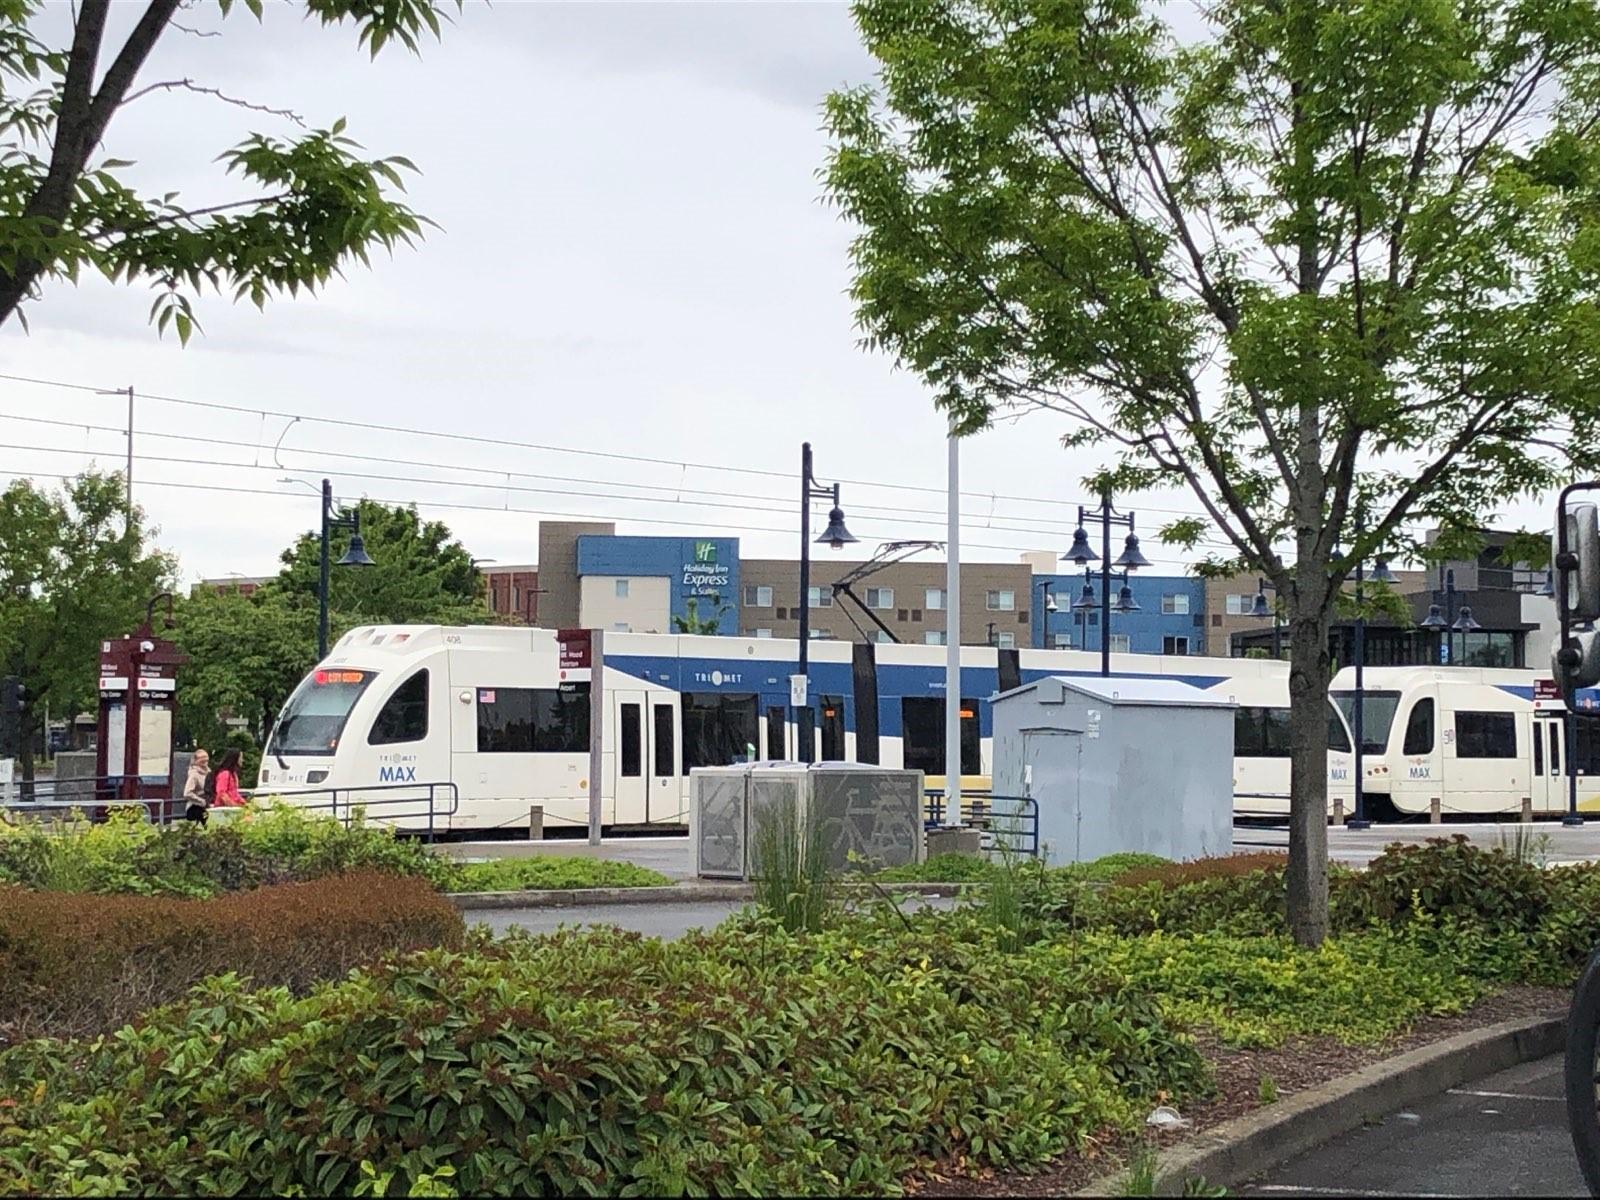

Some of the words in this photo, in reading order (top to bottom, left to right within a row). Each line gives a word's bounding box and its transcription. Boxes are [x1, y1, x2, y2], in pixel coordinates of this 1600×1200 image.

[683, 564, 714, 574] Holiday
[715, 564, 728, 573] Inn
[683, 573, 728, 587] Express
[379, 766, 416, 782] MAX
[1331, 769, 1347, 780] MAX
[1409, 768, 1431, 779] MAX
